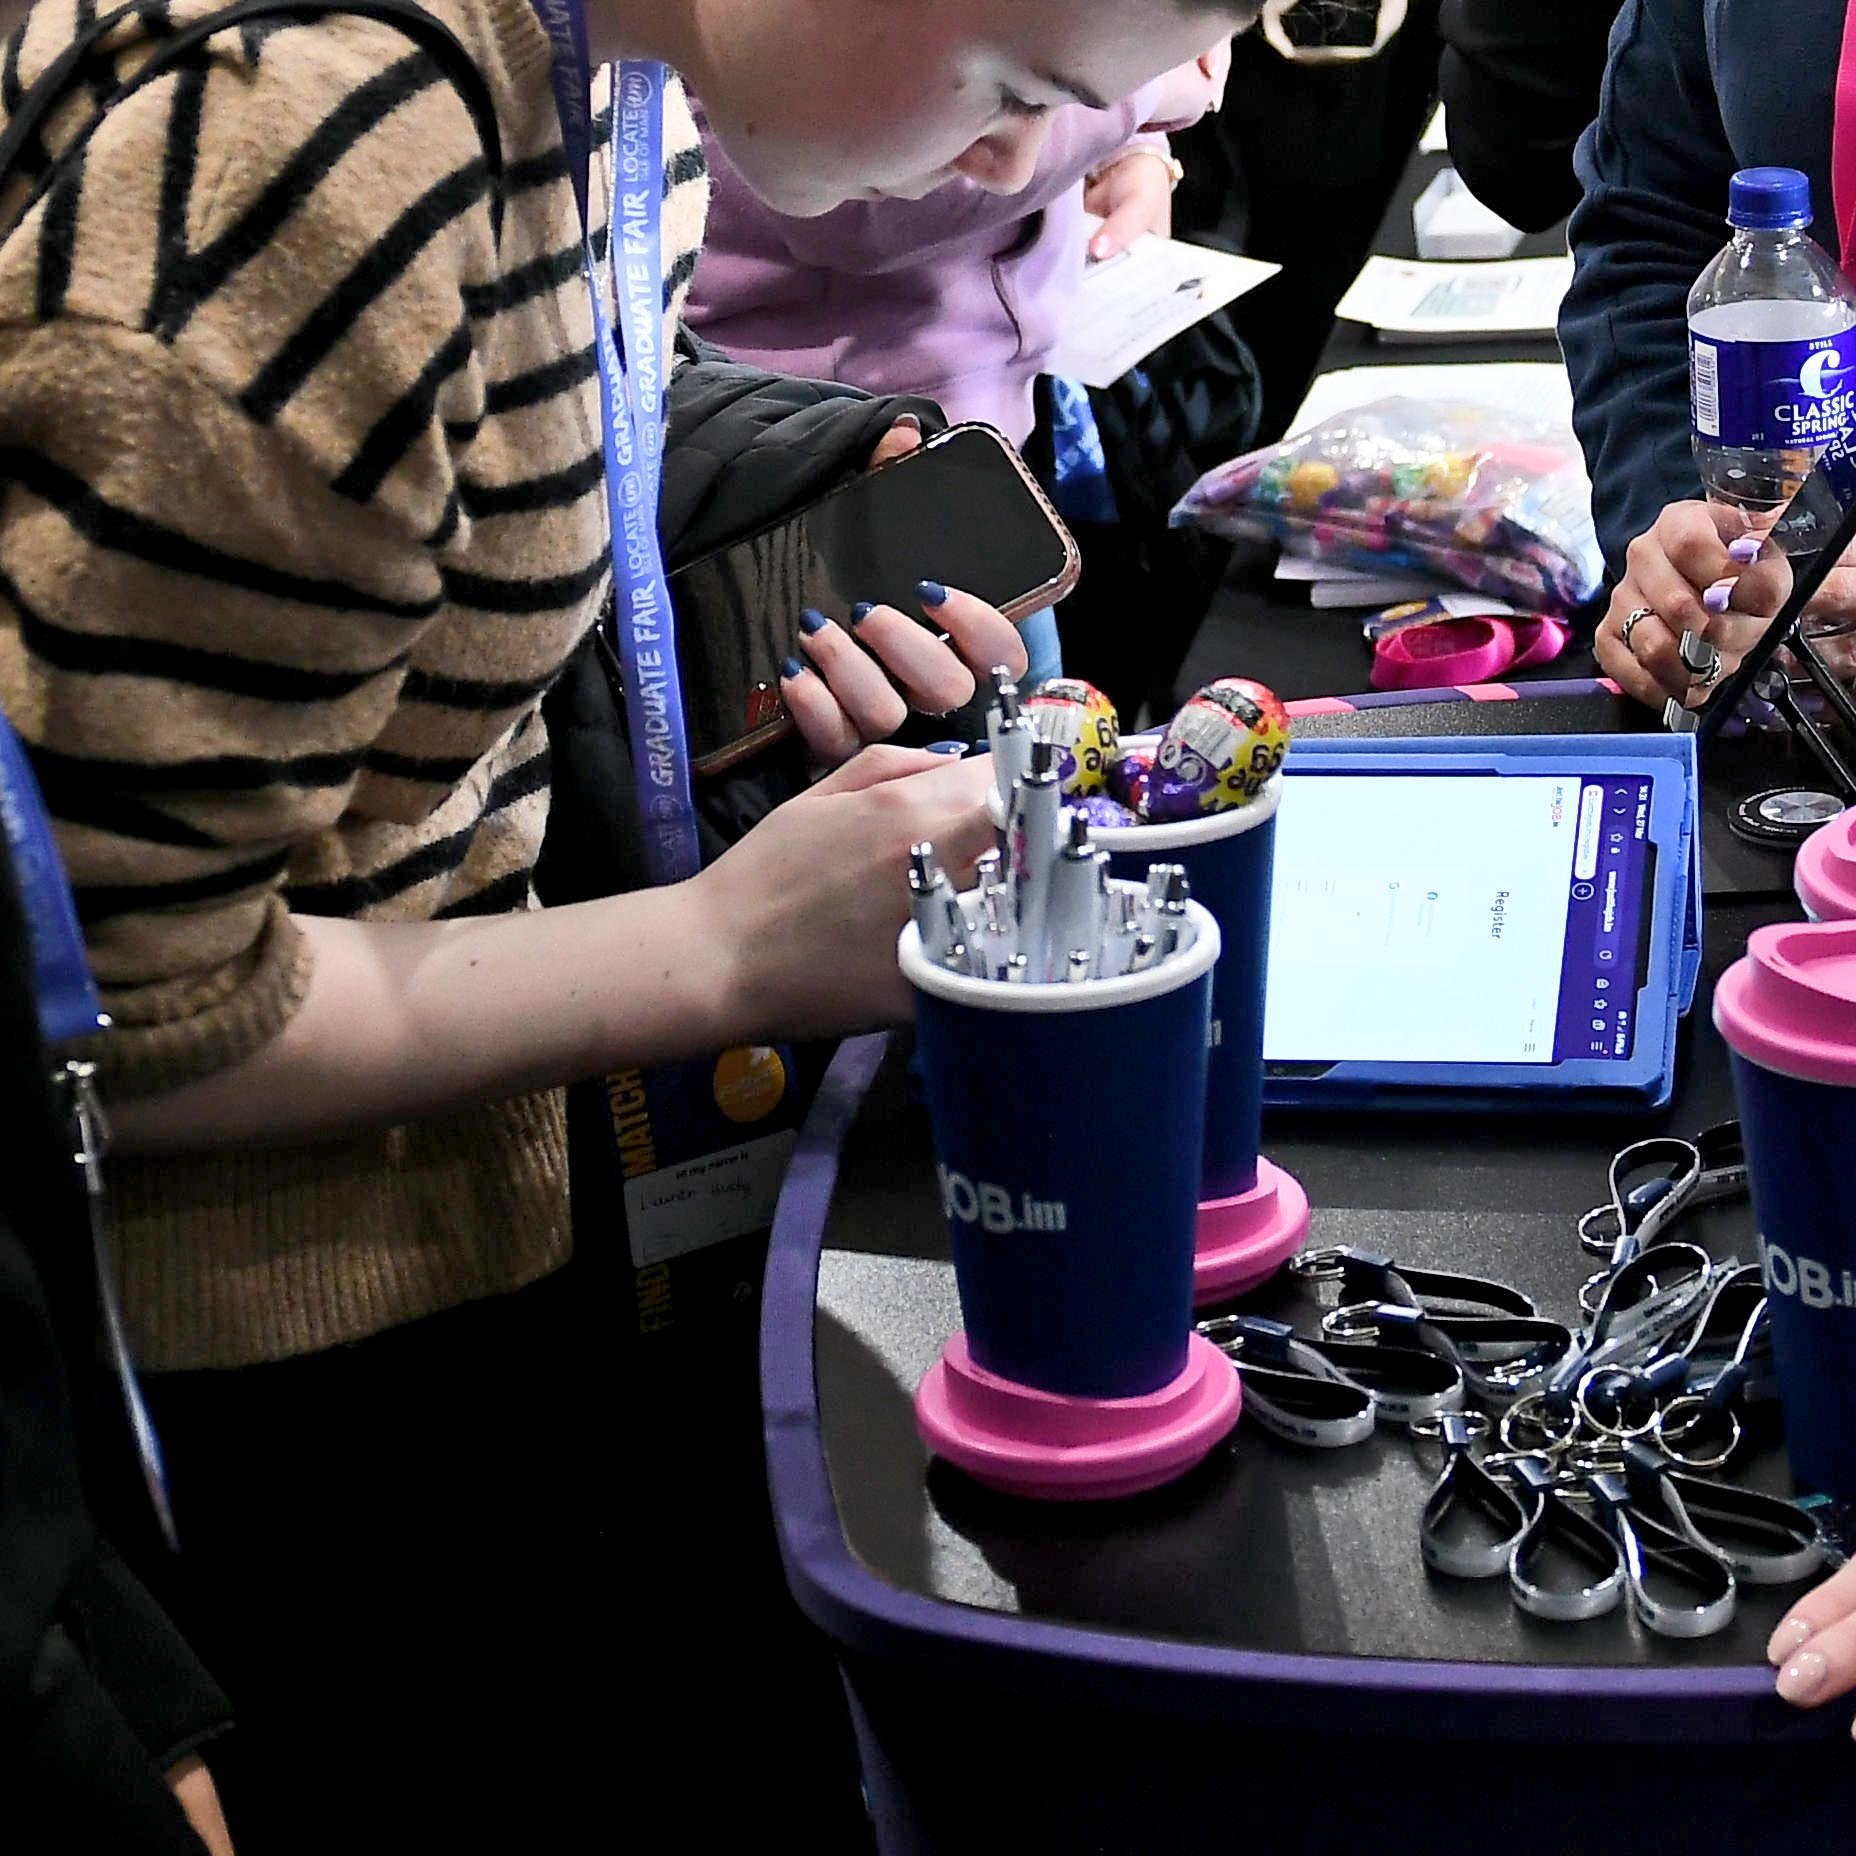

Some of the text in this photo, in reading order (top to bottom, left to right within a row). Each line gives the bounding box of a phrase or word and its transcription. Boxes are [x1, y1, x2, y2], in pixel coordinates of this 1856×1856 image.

[623, 109, 641, 183] LOCATE
[622, 188, 650, 255] FAIR
[626, 263, 658, 414] GRADUATE
[599, 327, 634, 467] GRADUATE
[1774, 390, 1855, 422] CLASSIC
[1791, 411, 1850, 436] SPRING
[624, 507, 646, 578] LOCATE
[629, 579, 675, 788] GRADUATE FAIR
[1491, 890, 1510, 940] Register
[605, 1068, 658, 1179] MATCH
